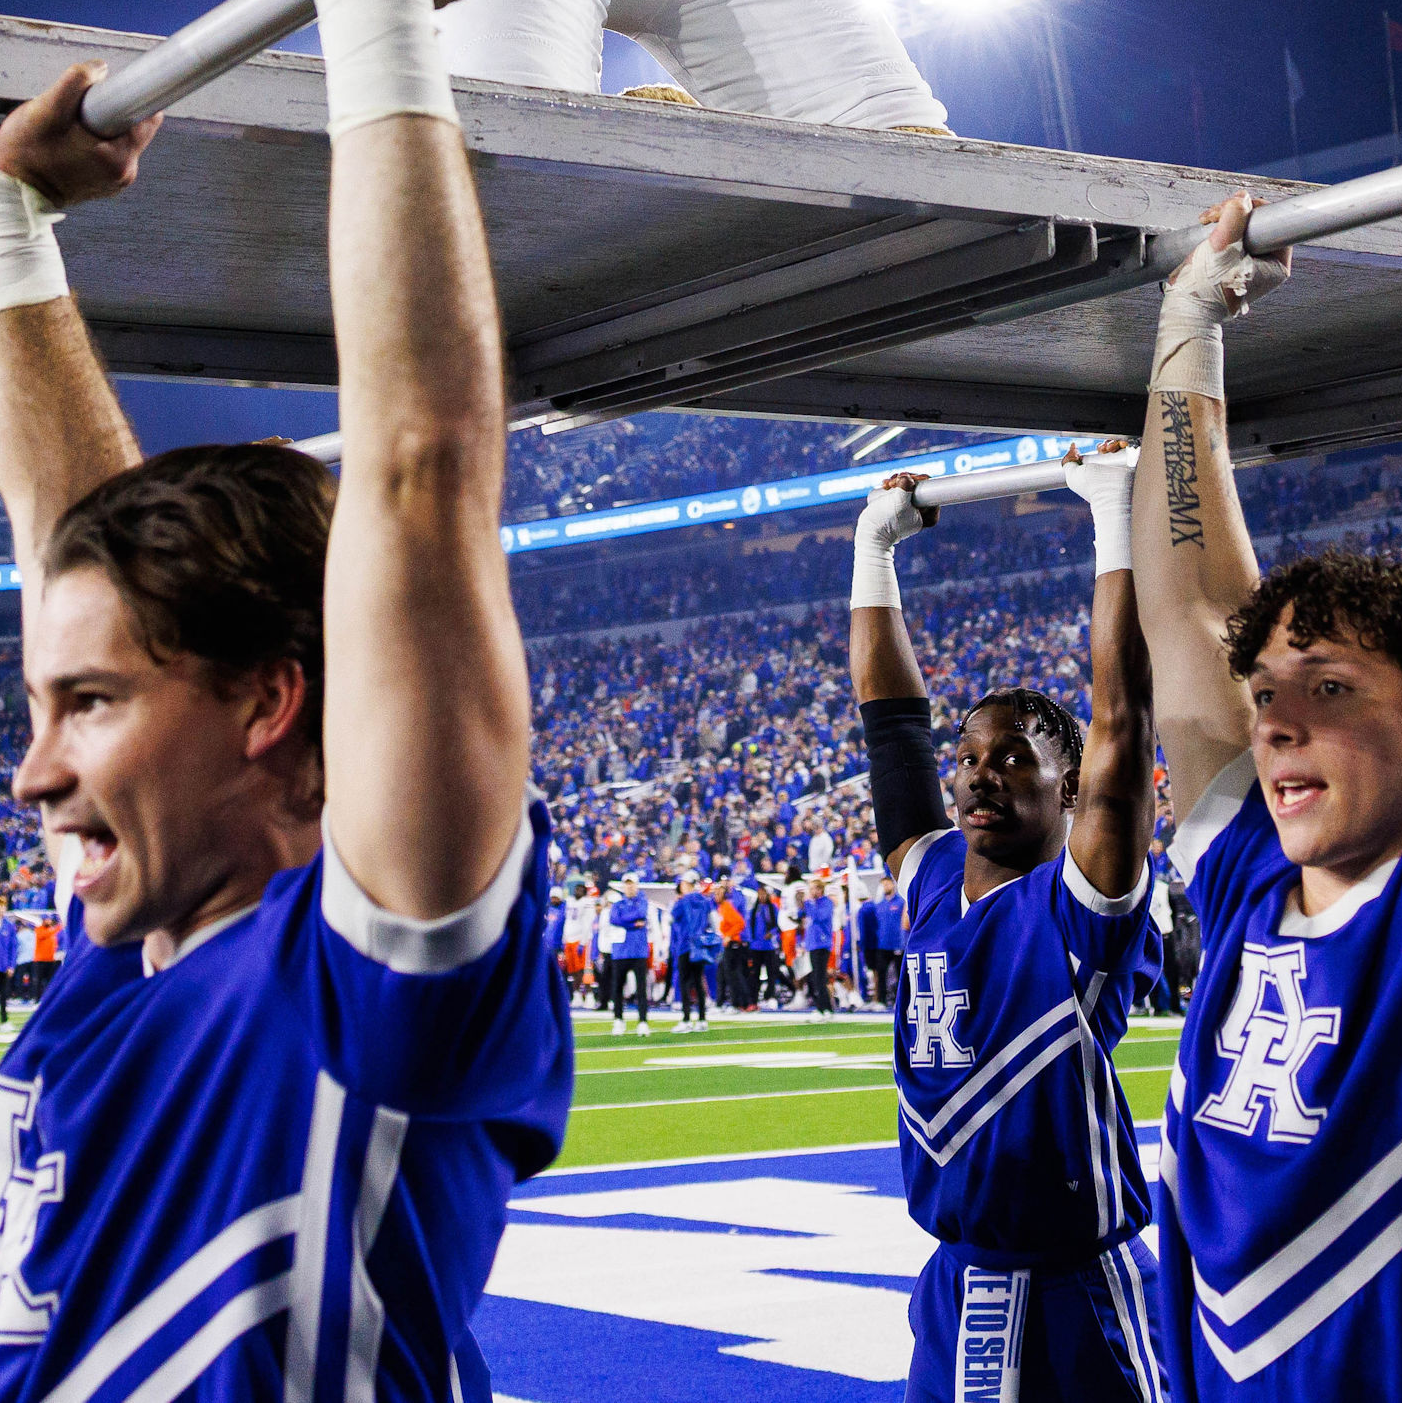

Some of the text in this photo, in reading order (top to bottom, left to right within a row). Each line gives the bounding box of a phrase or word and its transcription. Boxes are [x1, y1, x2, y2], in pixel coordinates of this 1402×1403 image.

[905, 950, 976, 1068] UK
[1193, 941, 1342, 1145] UK
[964, 1298, 1011, 1332] TO
